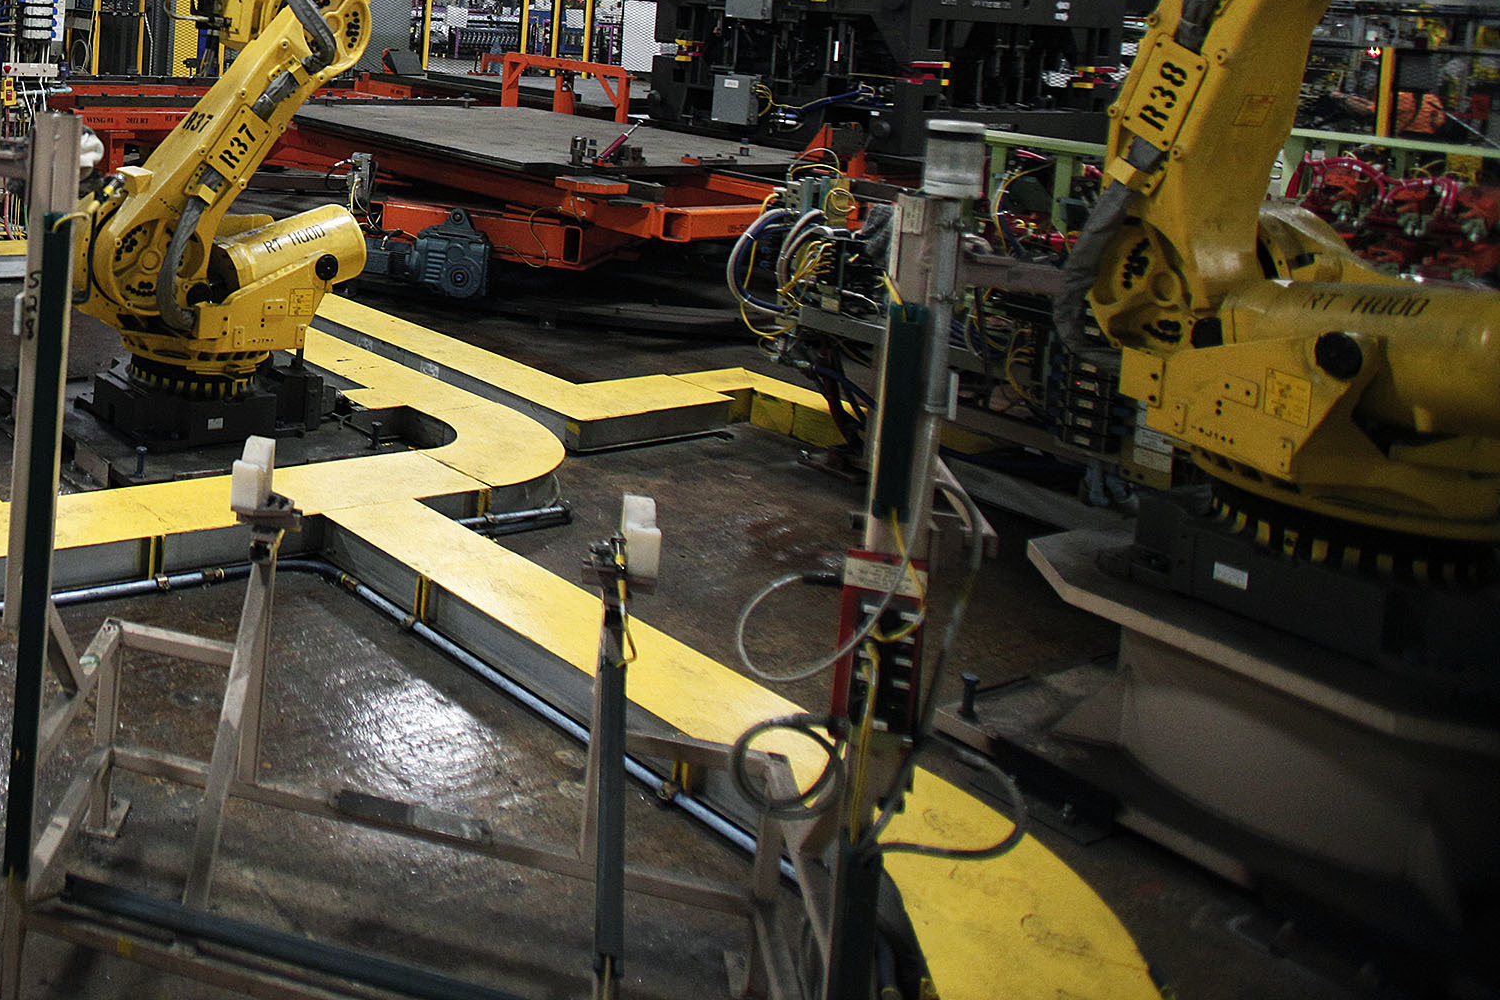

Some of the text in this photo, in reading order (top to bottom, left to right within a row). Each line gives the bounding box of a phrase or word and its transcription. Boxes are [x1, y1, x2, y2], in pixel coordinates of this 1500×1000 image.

[1139, 61, 1188, 132] R38
[182, 111, 214, 133] R37
[219, 122, 256, 170] R37
[262, 224, 326, 254] RT HOOD
[1350, 296, 1430, 317] HOOD
